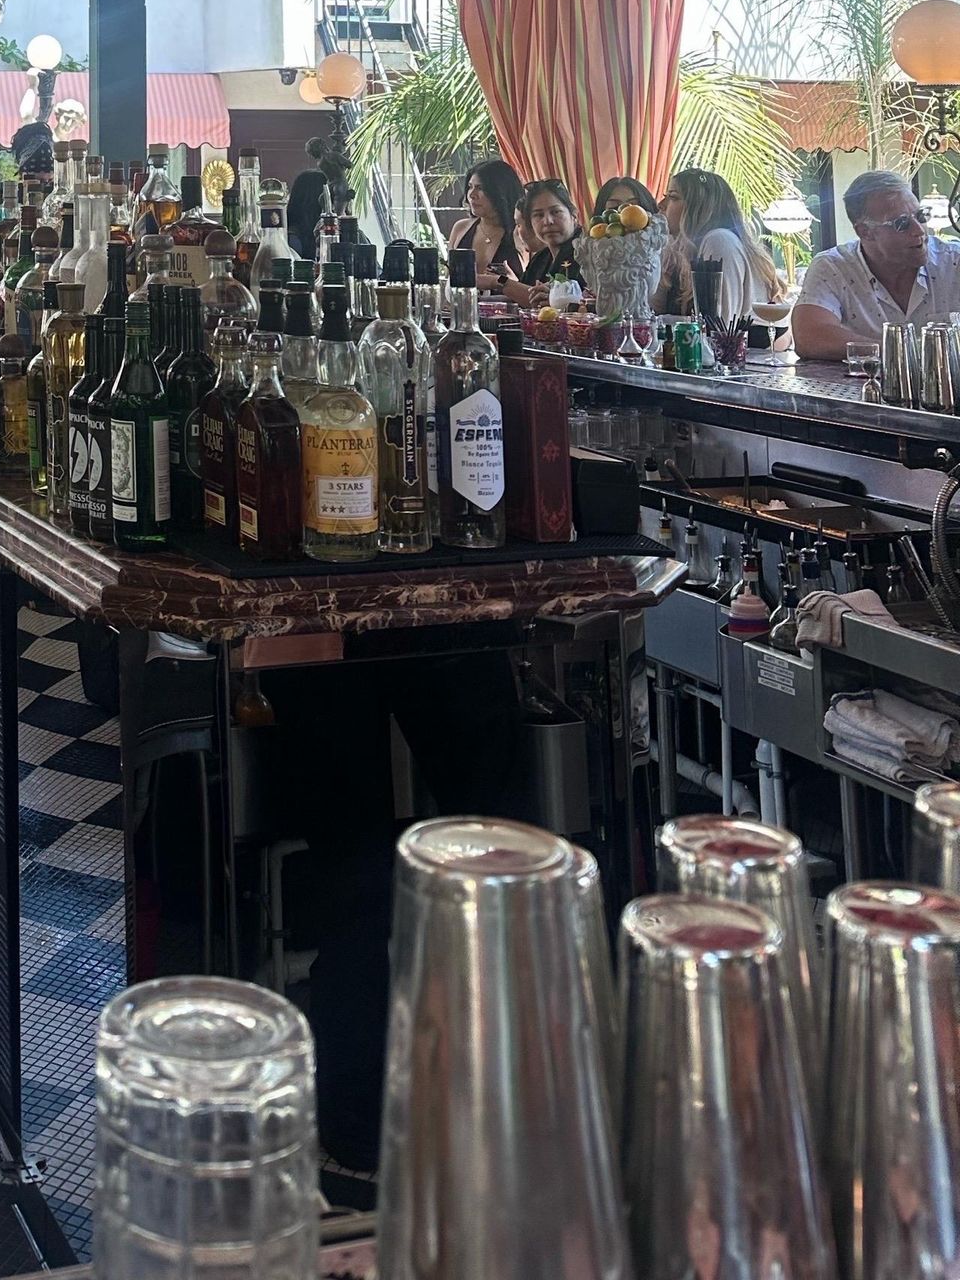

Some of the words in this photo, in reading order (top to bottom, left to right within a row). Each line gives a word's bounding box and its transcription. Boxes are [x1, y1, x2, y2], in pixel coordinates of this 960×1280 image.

[170, 252, 188, 271] NOB
[168, 271, 193, 279] CREEK
[202, 413, 223, 436] ELIJAH
[405, 399, 415, 463] ST-GERMAIN
[202, 428, 224, 452] CRAIG
[476, 443, 494, 451] 100%
[329, 482, 334, 490] 3
[336, 482, 364, 491] STARS
